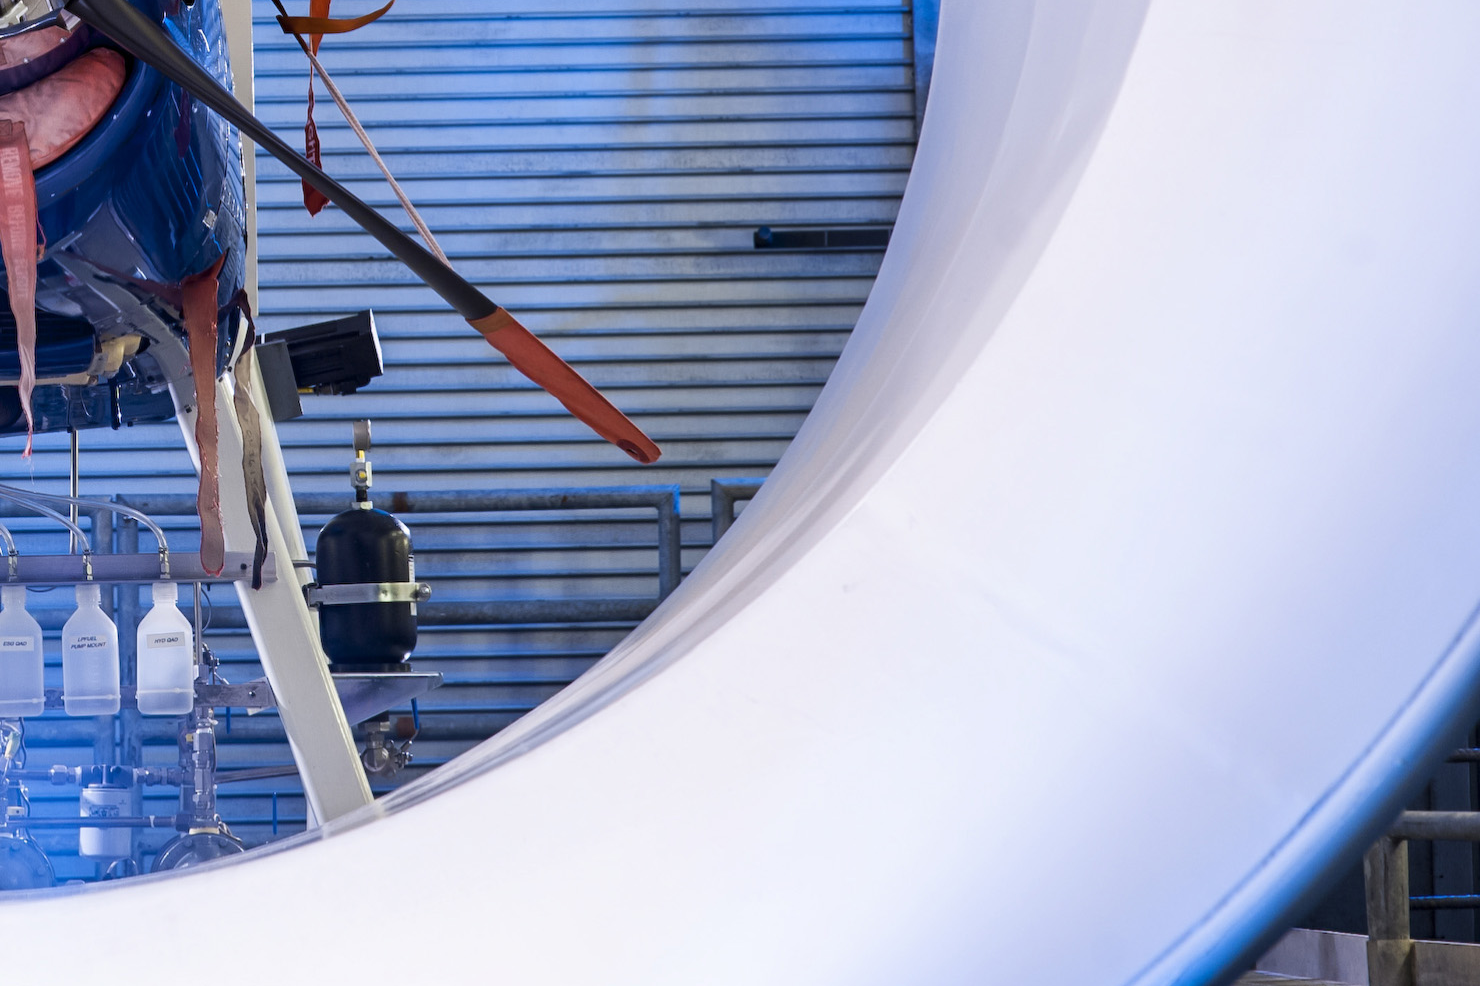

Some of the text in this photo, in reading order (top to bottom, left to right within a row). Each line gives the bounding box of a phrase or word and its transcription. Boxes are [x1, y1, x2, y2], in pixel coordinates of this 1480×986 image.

[0, 147, 29, 298] REMOVE BEFORE FLIGHT
